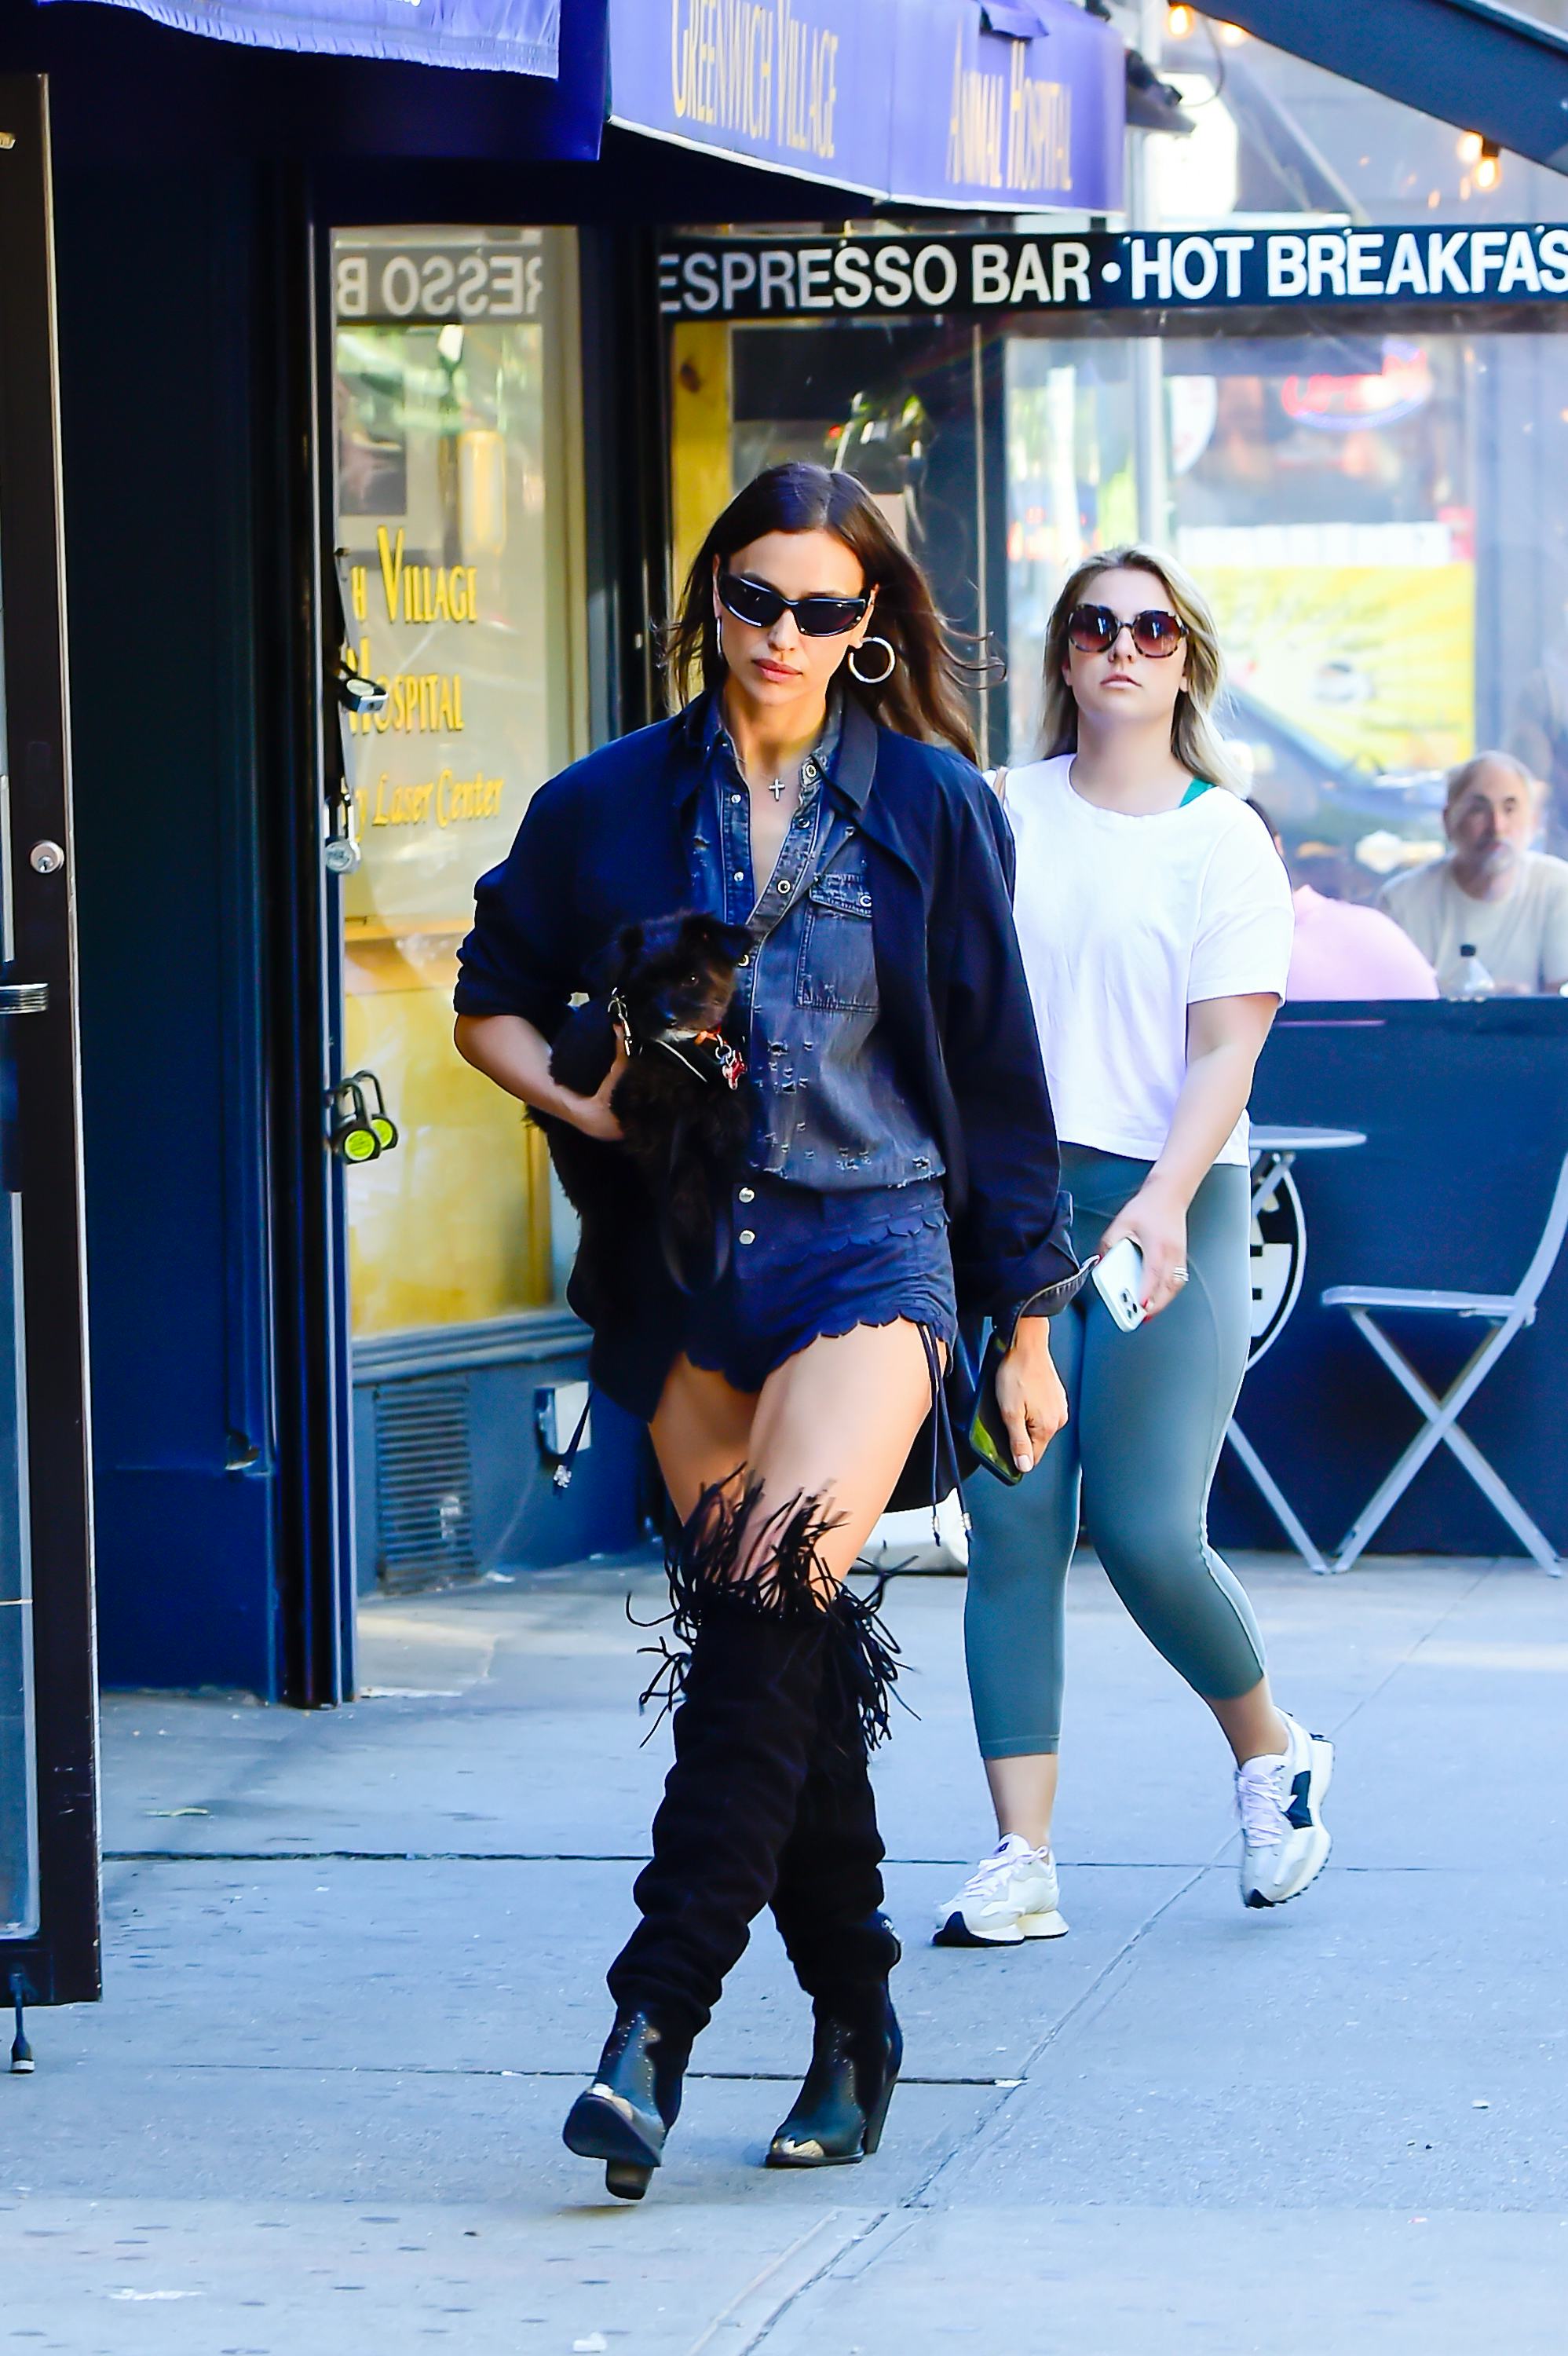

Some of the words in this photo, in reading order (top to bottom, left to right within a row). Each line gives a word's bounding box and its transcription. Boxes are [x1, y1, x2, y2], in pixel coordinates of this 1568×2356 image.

[671, 0, 773, 140] GREENWICH
[777, 0, 838, 159] VILLAGE
[659, 243, 958, 313] ESPRESSO
[971, 241, 1091, 305] BAR
[1131, 236, 1255, 300] HOT
[1266, 229, 1568, 297] BREAKFAS
[376, 524, 477, 624] VILLAGE
[371, 772, 433, 827] Laser
[436, 769, 504, 829] Center
